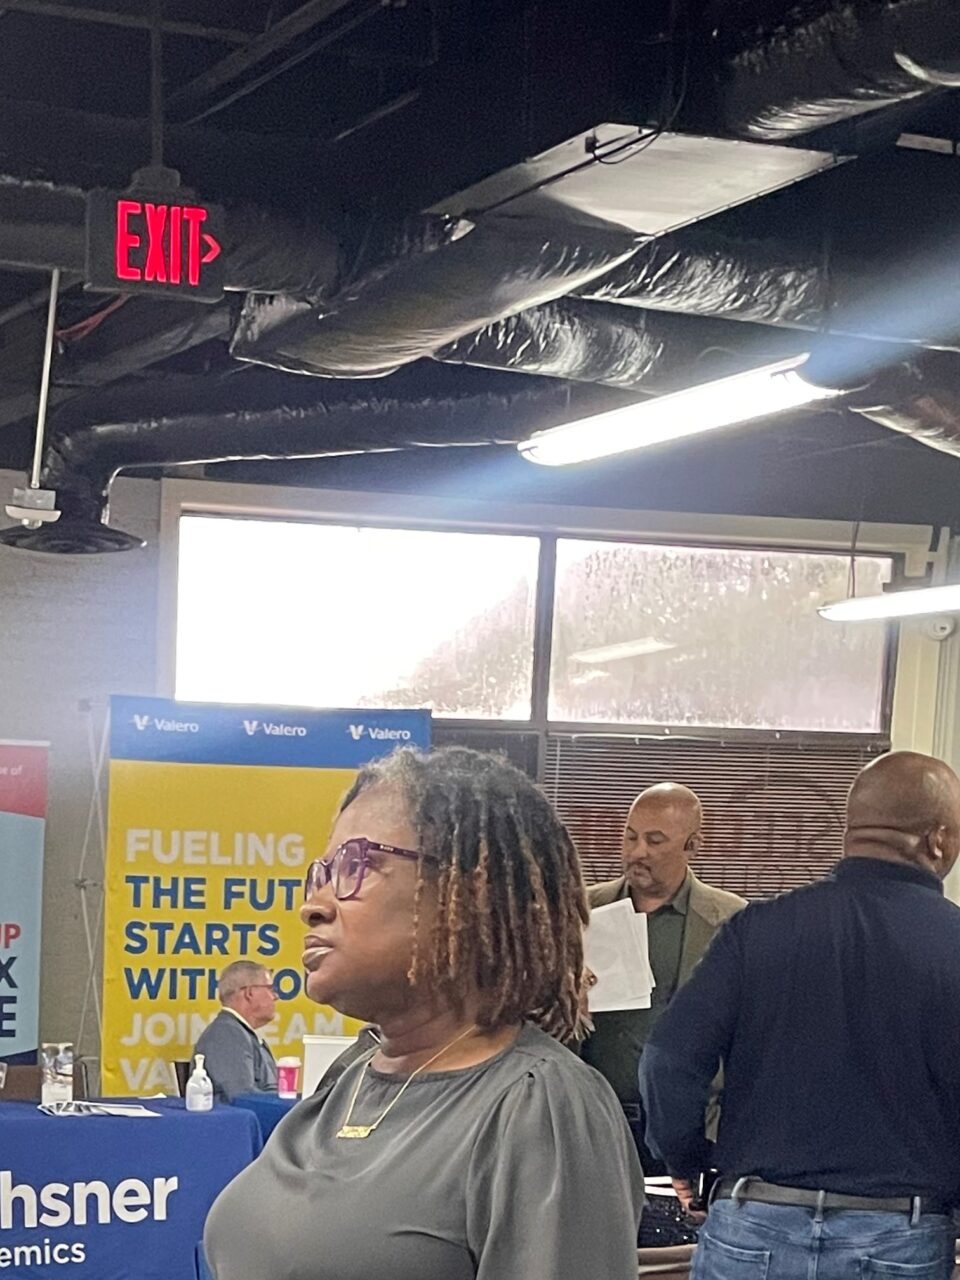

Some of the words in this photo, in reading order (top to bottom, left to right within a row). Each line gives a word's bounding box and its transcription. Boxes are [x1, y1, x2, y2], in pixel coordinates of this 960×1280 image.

[117, 201, 207, 285] EXIT
[154, 718, 200, 733] Valero
[262, 722, 307, 737] Valero
[368, 727, 411, 741] Valero
[10, 765, 23, 776] of
[125, 829, 306, 867] FUELING
[125, 875, 207, 909] THE
[223, 878, 302, 911] FUT
[124, 921, 281, 957] STARTS
[265, 1012, 344, 1045] EAM
